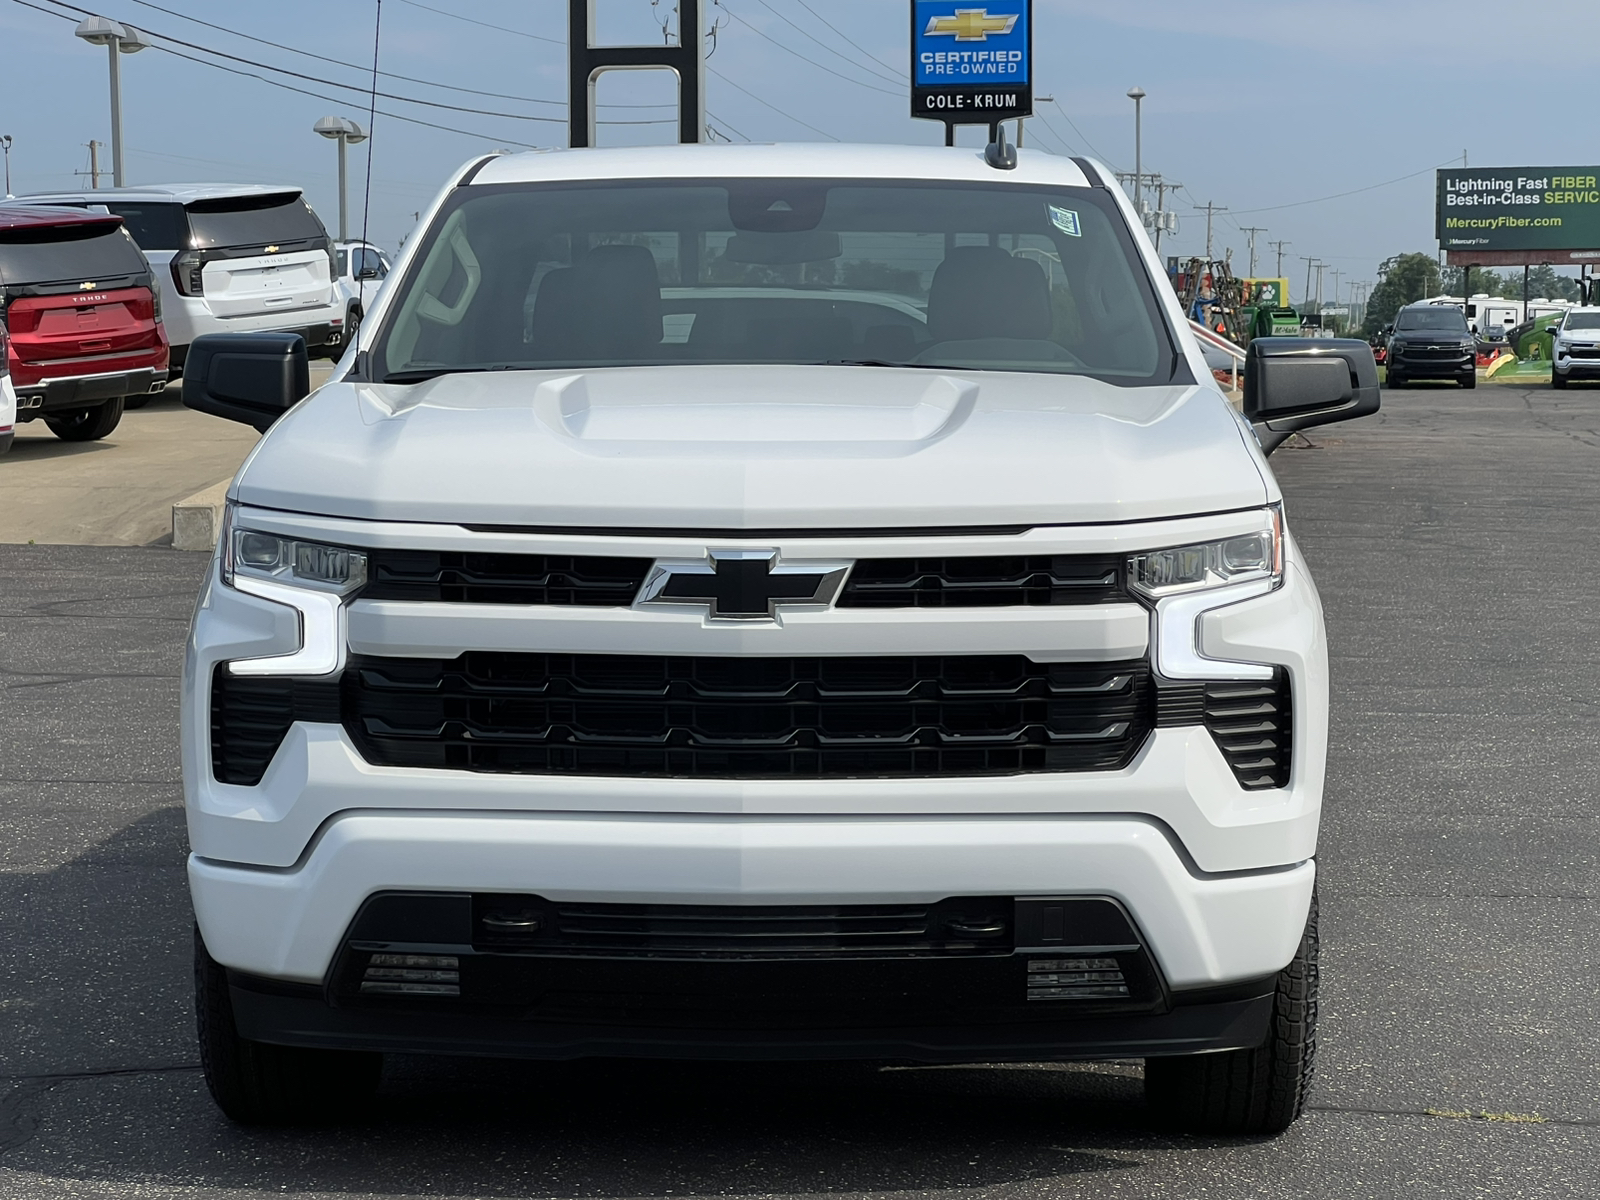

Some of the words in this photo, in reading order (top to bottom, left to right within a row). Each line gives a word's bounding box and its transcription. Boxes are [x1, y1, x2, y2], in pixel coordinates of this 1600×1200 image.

[920, 51, 1022, 63] CERTIFIED
[925, 63, 1017, 74] PRE-OWNED
[1446, 178, 1514, 194] Lightning
[1517, 177, 1548, 190] Fast
[1552, 176, 1597, 189] FIBER
[1446, 192, 1541, 206] Best-in-Class
[1446, 216, 1562, 230] MercuryFiber.com
[1452, 238, 1490, 246] MercuryFiber
[72, 294, 108, 303] TAHOE
